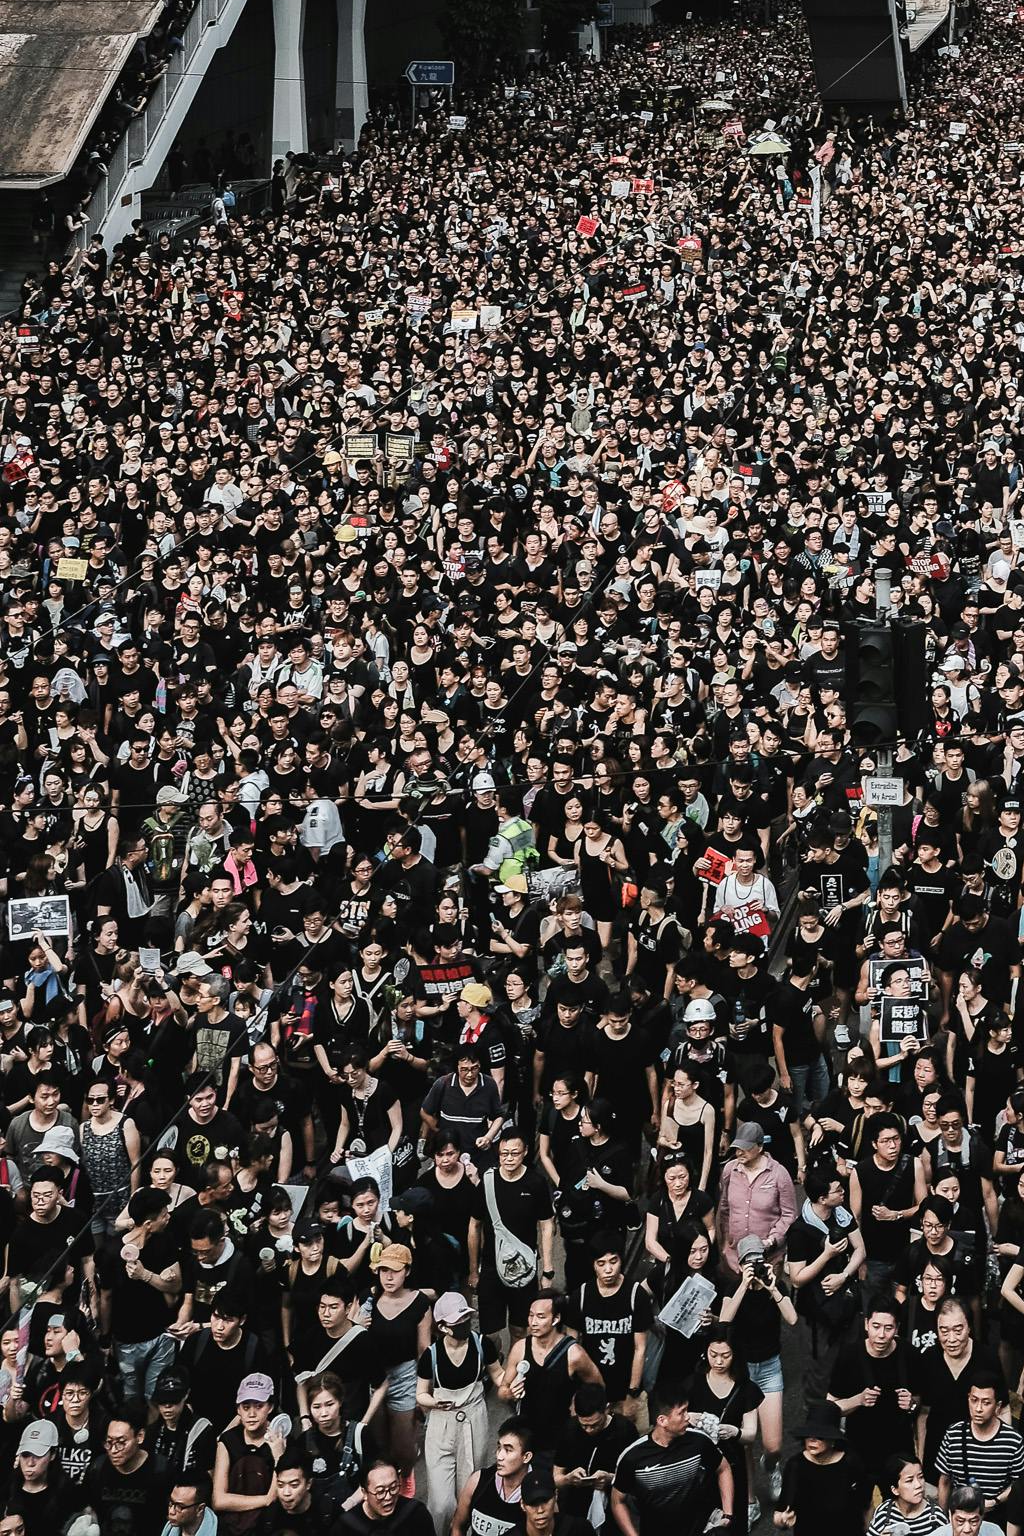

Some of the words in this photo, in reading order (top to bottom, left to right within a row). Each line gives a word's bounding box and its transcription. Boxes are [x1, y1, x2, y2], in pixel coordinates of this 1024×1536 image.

[420, 72, 438, 80] 九龍
[911, 558, 932, 567] STOP
[871, 792, 880, 801] My
[585, 1314, 633, 1335] BERLIN
